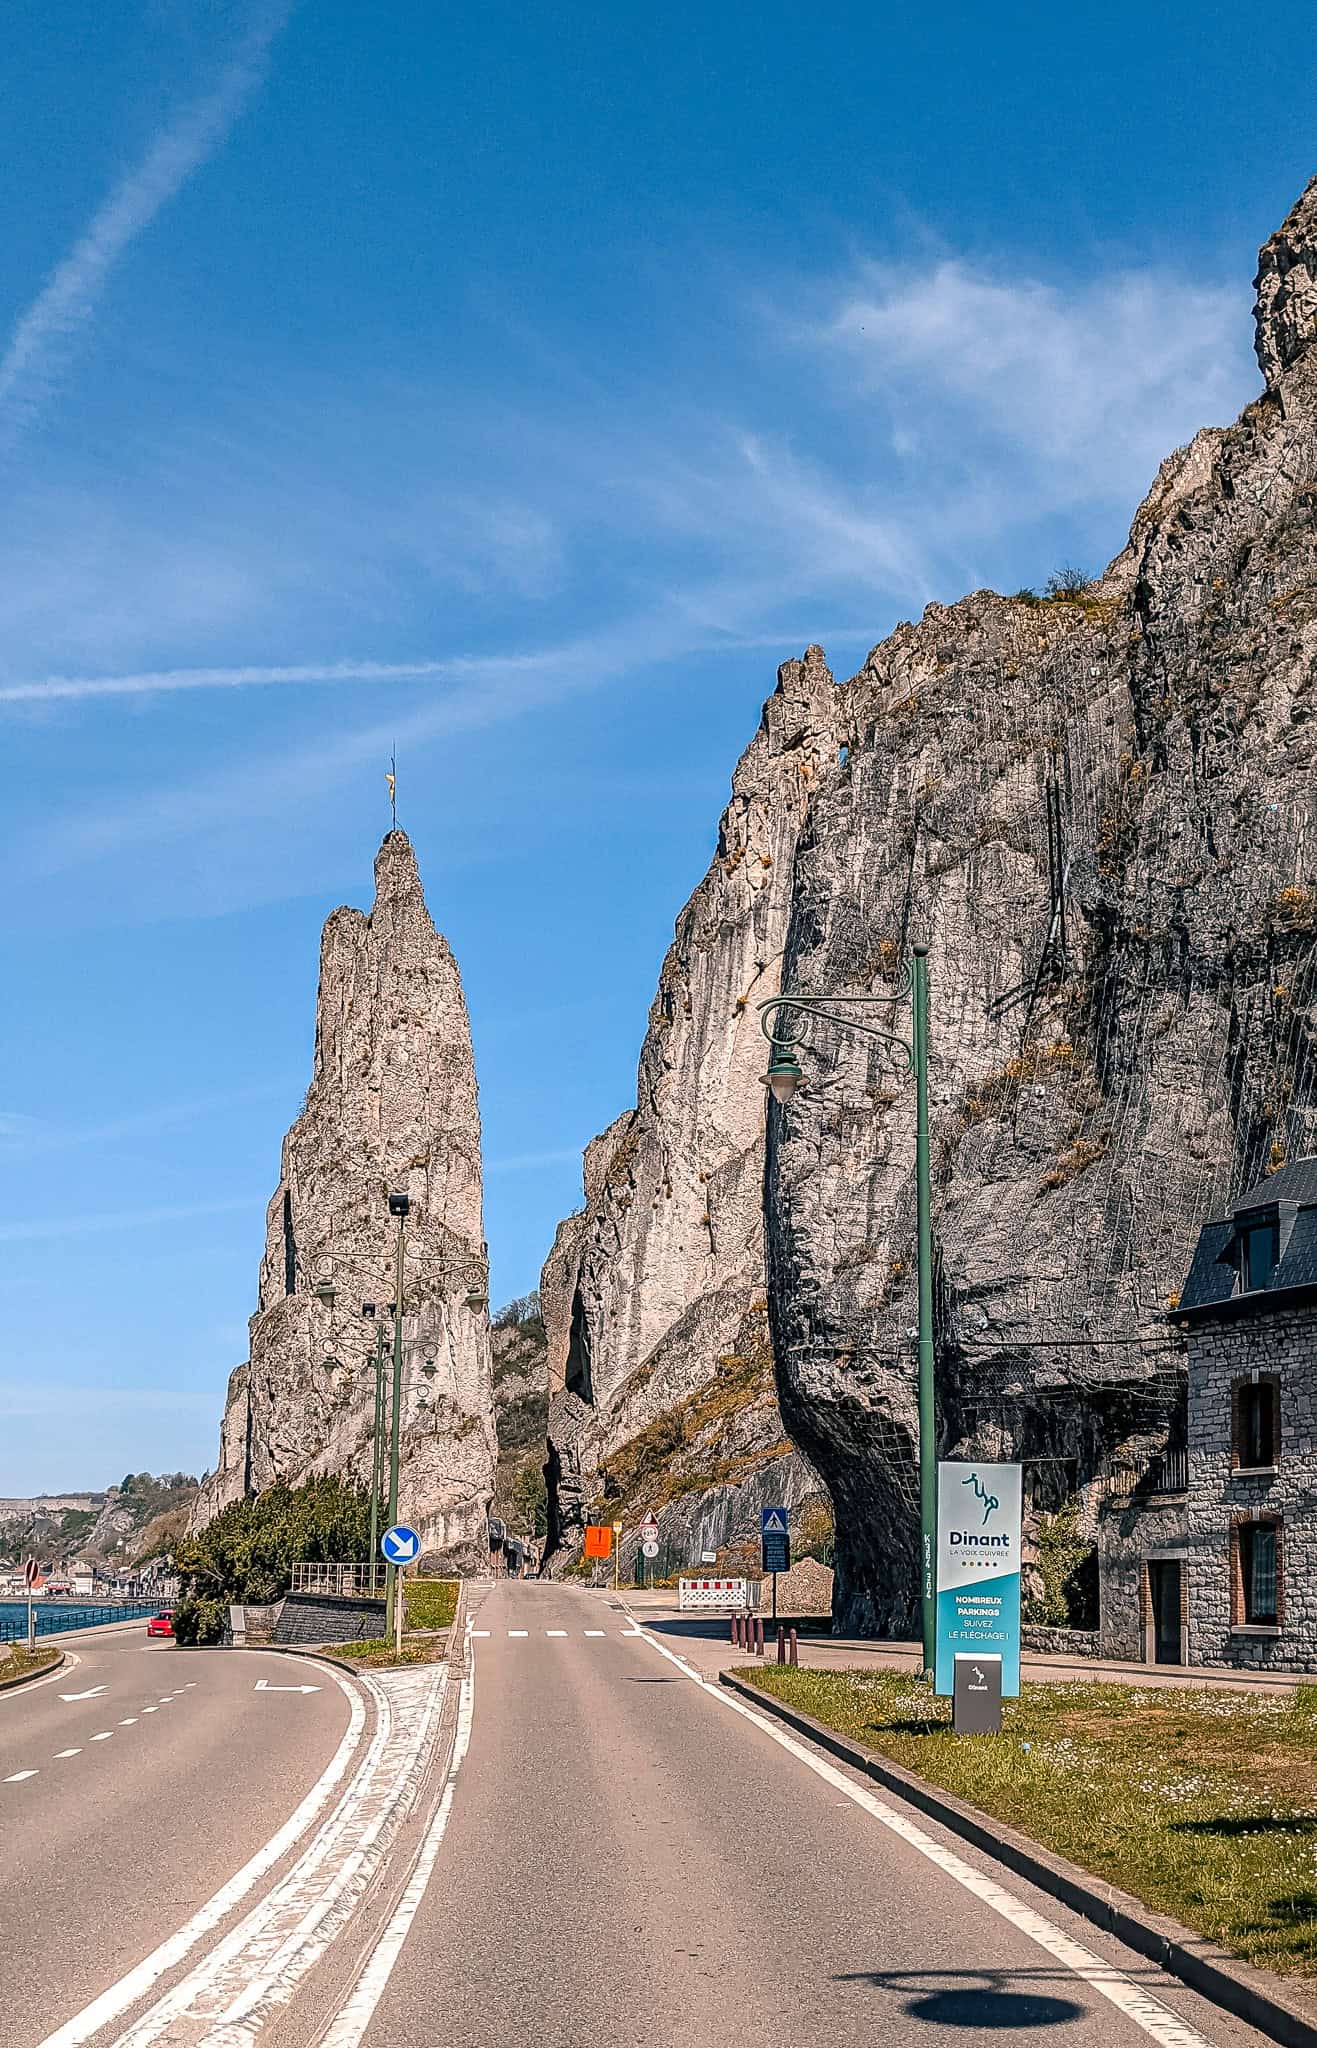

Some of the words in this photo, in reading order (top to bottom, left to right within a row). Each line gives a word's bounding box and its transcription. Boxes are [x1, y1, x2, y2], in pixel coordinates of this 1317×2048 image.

[950, 1530, 1010, 1547] Dinant
[955, 1596, 1003, 1605] NOMBREUX
[957, 1607, 1000, 1616] PARKINGS
[963, 1619, 993, 1628] SUIVEZ
[948, 1631, 959, 1639] LE
